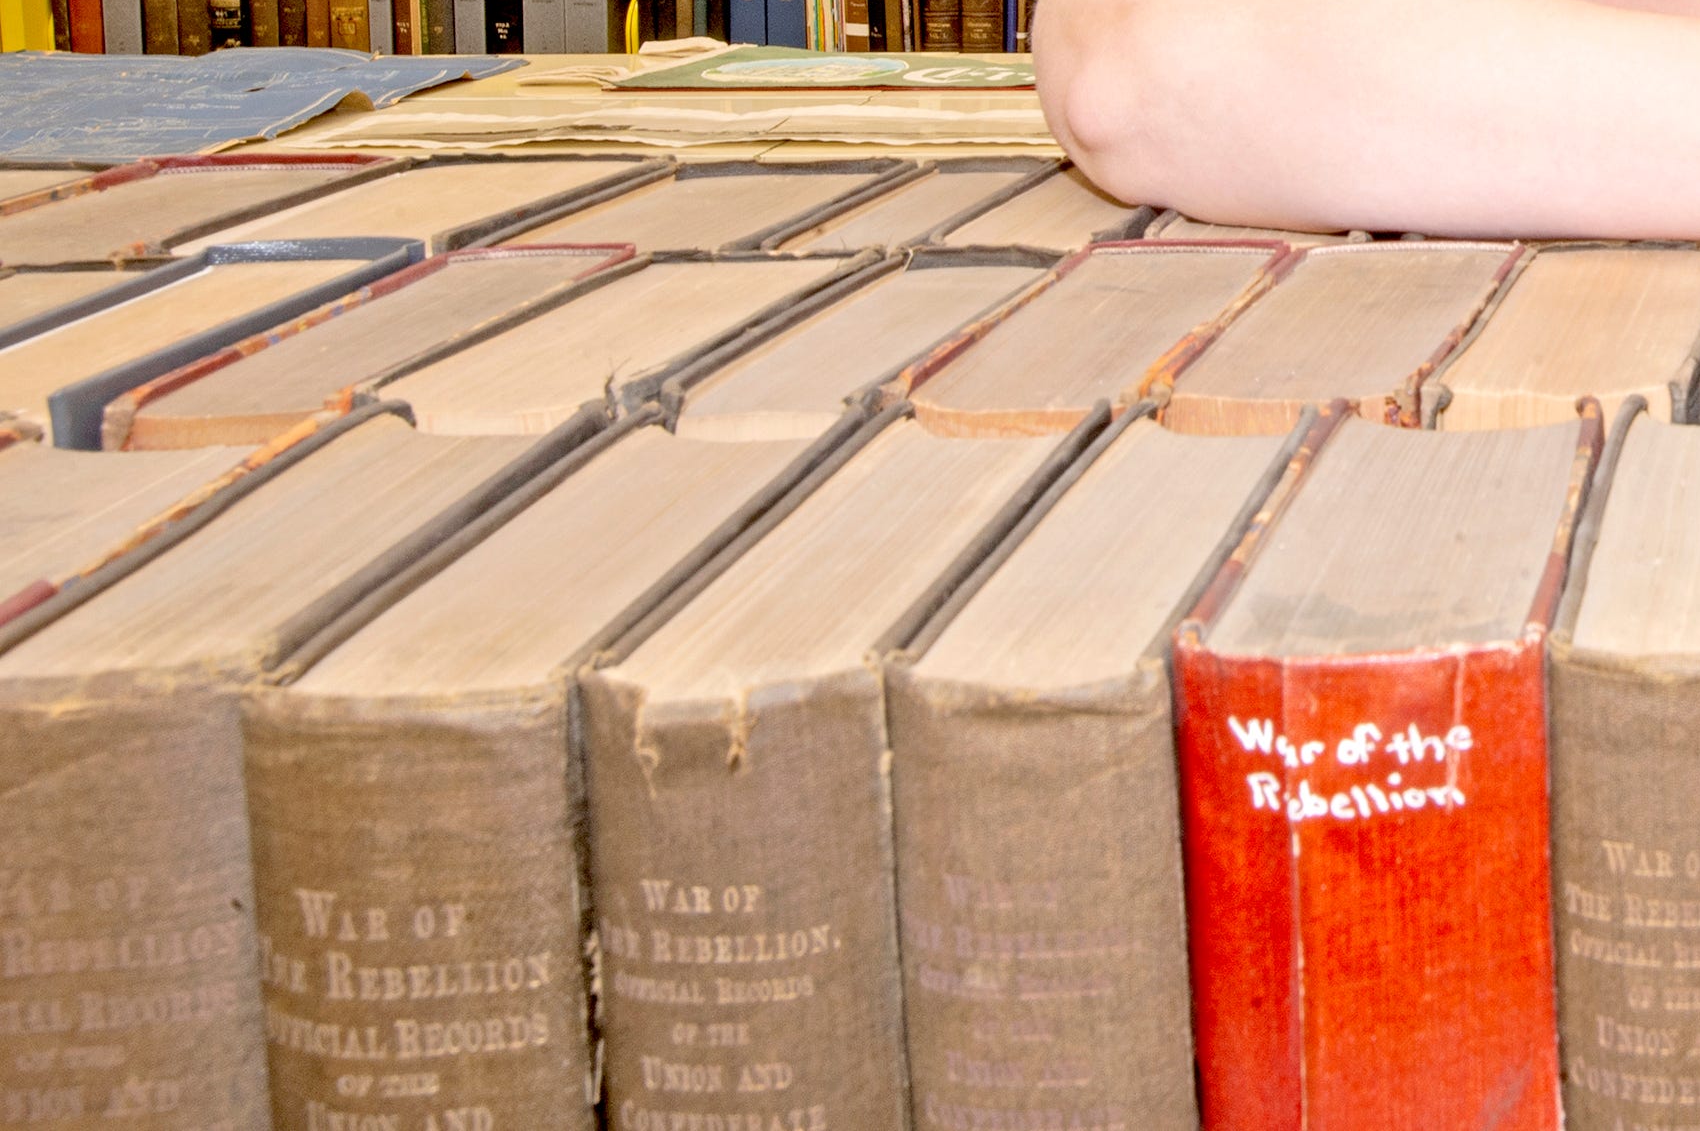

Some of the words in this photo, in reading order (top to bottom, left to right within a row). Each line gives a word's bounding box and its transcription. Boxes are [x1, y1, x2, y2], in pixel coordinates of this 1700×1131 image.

[1228, 715, 1325, 767] War
[1337, 722, 1382, 764] of
[1386, 722, 1474, 765] the
[1247, 772, 1467, 821] Rebellion
[1602, 839, 1674, 878] WAR
[296, 887, 391, 941] WAR
[414, 903, 466, 939] OF
[640, 879, 711, 914] WAR
[722, 883, 762, 914] OF
[1564, 881, 1612, 922] THE
[326, 950, 551, 1000] REBELLION
[394, 1013, 549, 1059] RECORDS
[671, 1020, 699, 1047] OF
[706, 1022, 750, 1047] THE
[1597, 1014, 1679, 1056] UNION
[336, 1074, 374, 1097] OF
[640, 1054, 722, 1093] UNION
[738, 1061, 794, 1093] AND
